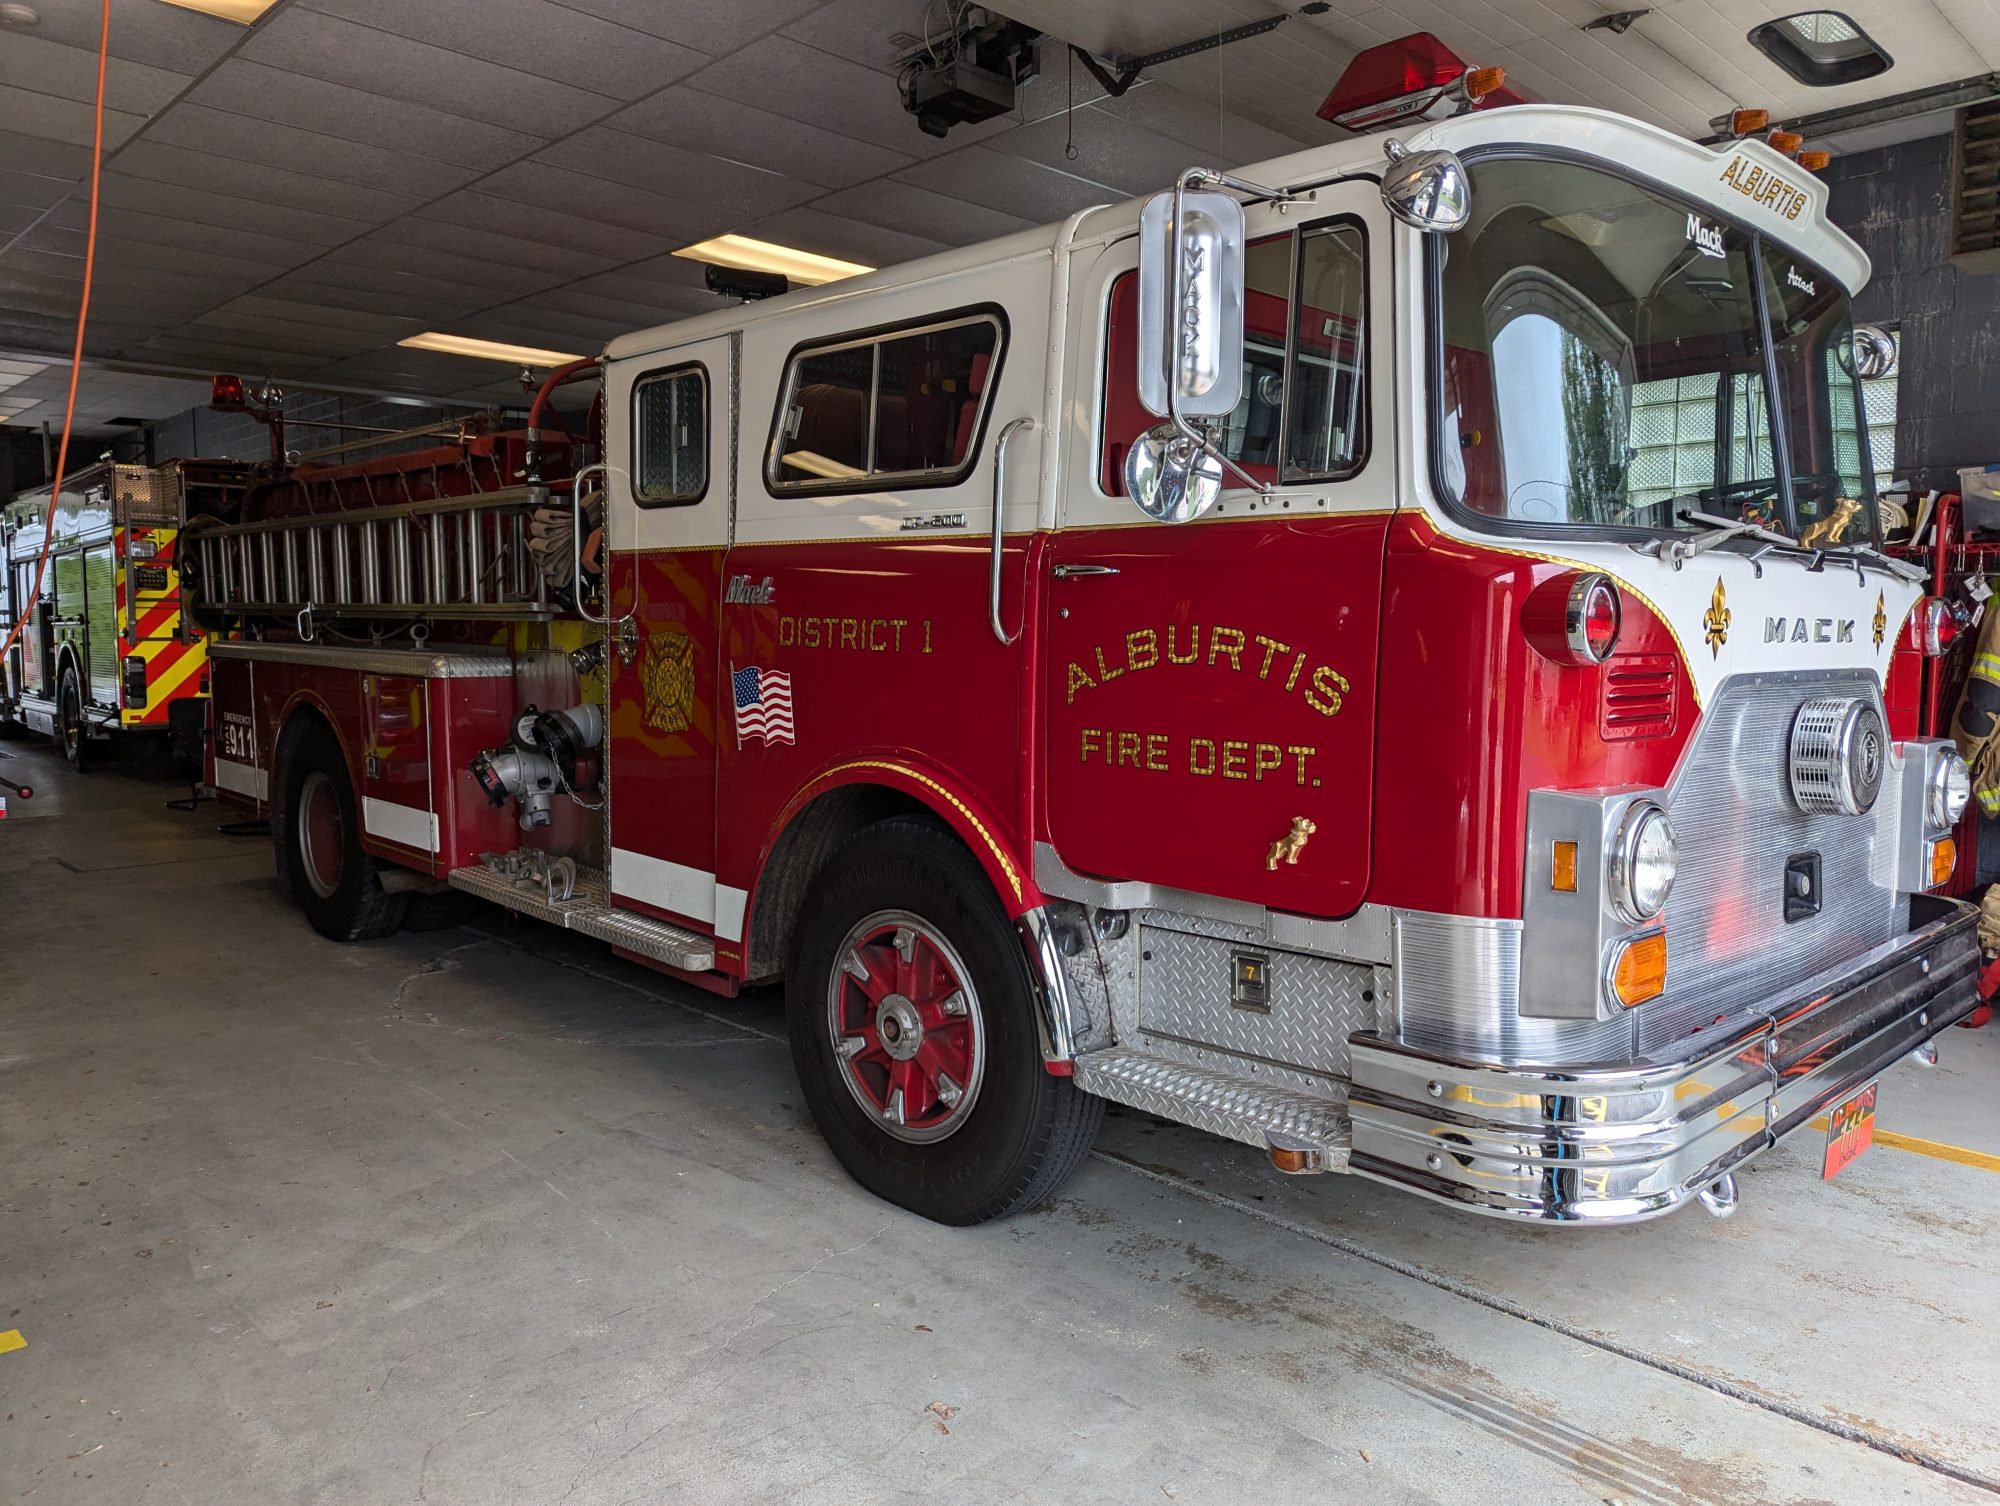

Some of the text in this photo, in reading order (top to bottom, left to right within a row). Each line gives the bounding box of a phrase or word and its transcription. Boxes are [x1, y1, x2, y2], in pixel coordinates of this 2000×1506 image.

[1396, 103, 1412, 113] CODE
[1719, 155, 1808, 221] ALBURTIS
[1686, 213, 1726, 258] Mack
[1787, 264, 1816, 296] Attack
[1183, 247, 1205, 358] MACK
[779, 616, 933, 653] DISTRICT 1
[1763, 616, 1855, 643] MACK
[1067, 624, 1350, 718] ALBURTIS
[229, 724, 254, 760] 911
[1080, 728, 1322, 788] FIRE DEPT.
